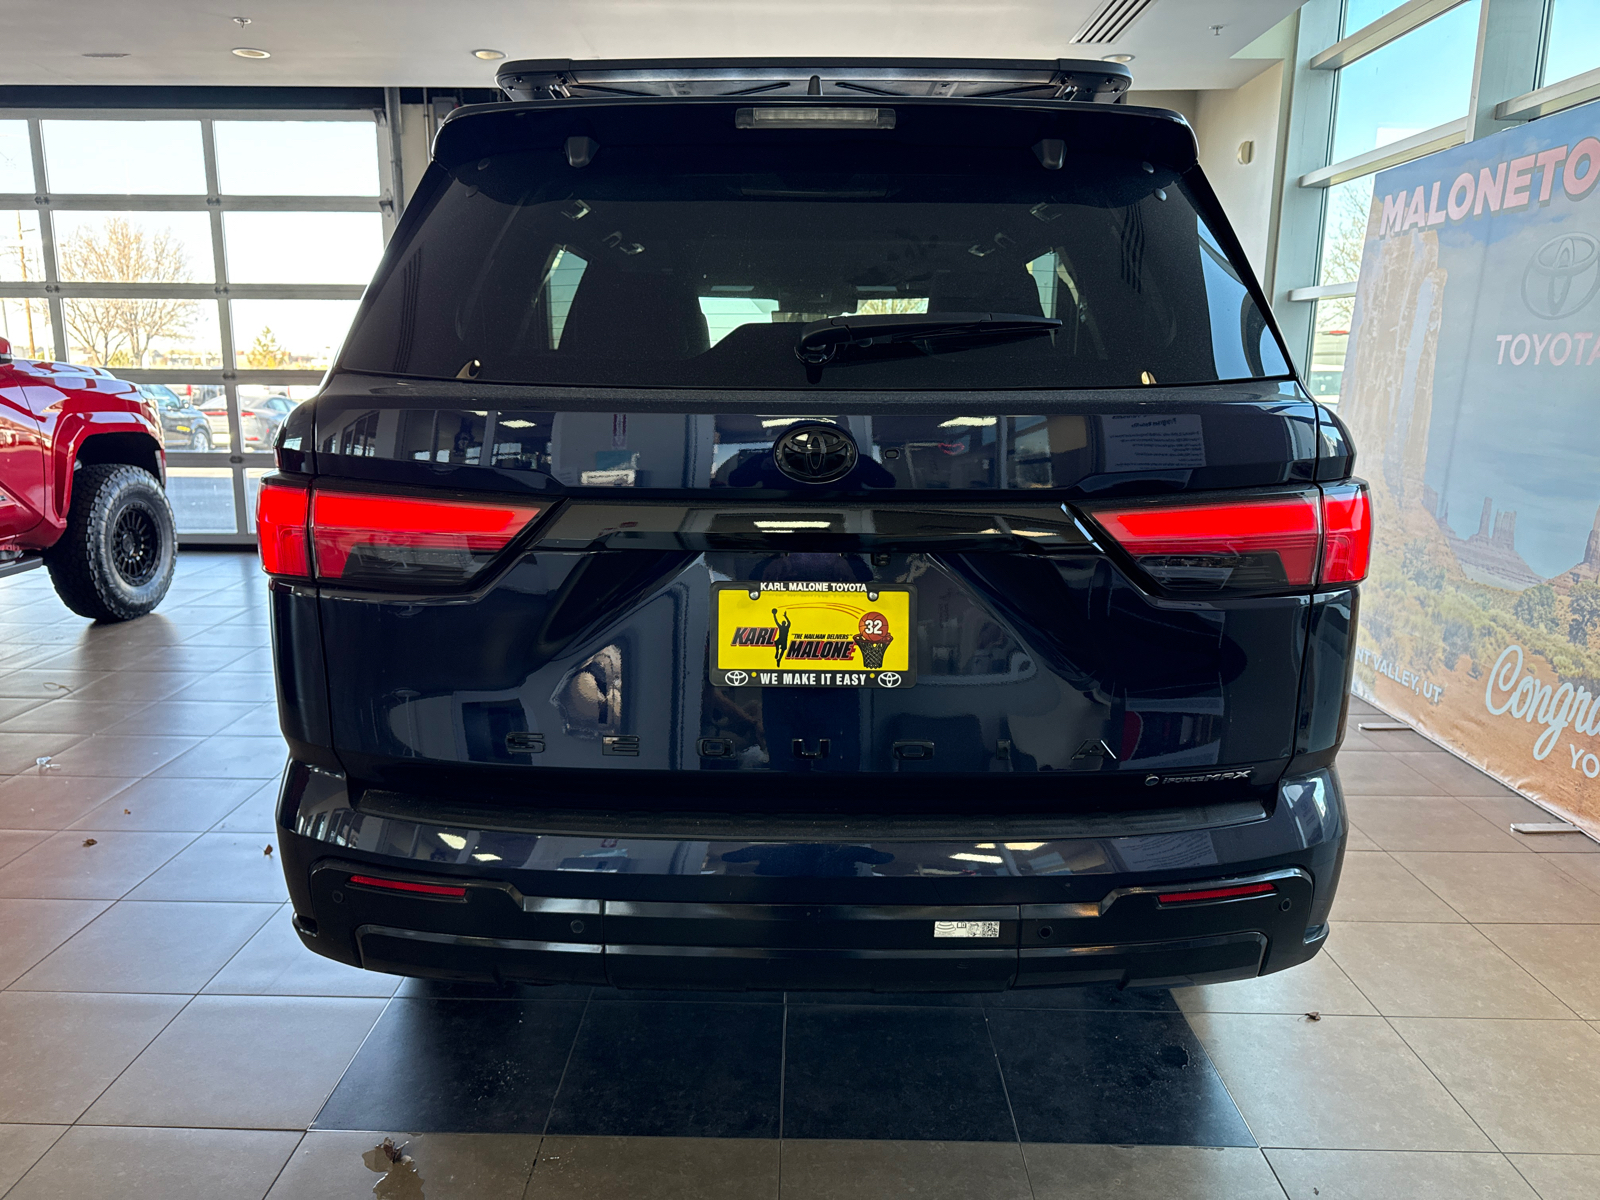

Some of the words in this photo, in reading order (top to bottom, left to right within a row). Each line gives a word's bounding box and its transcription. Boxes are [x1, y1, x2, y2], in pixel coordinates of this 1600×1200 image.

[760, 582, 786, 591] KARL
[789, 582, 829, 592] MALONE
[830, 583, 867, 592] TOYOTA
[864, 619, 883, 634] 32
[731, 627, 778, 647] KARL
[785, 640, 856, 660] MALONE
[760, 672, 779, 684] WE
[783, 673, 816, 685] MAKE
[820, 673, 833, 685] IT
[837, 673, 866, 685] EASY
[1373, 655, 1419, 696] VALLEY,
[1423, 680, 1442, 703] UT
[505, 731, 1117, 760] SEQUOIA
